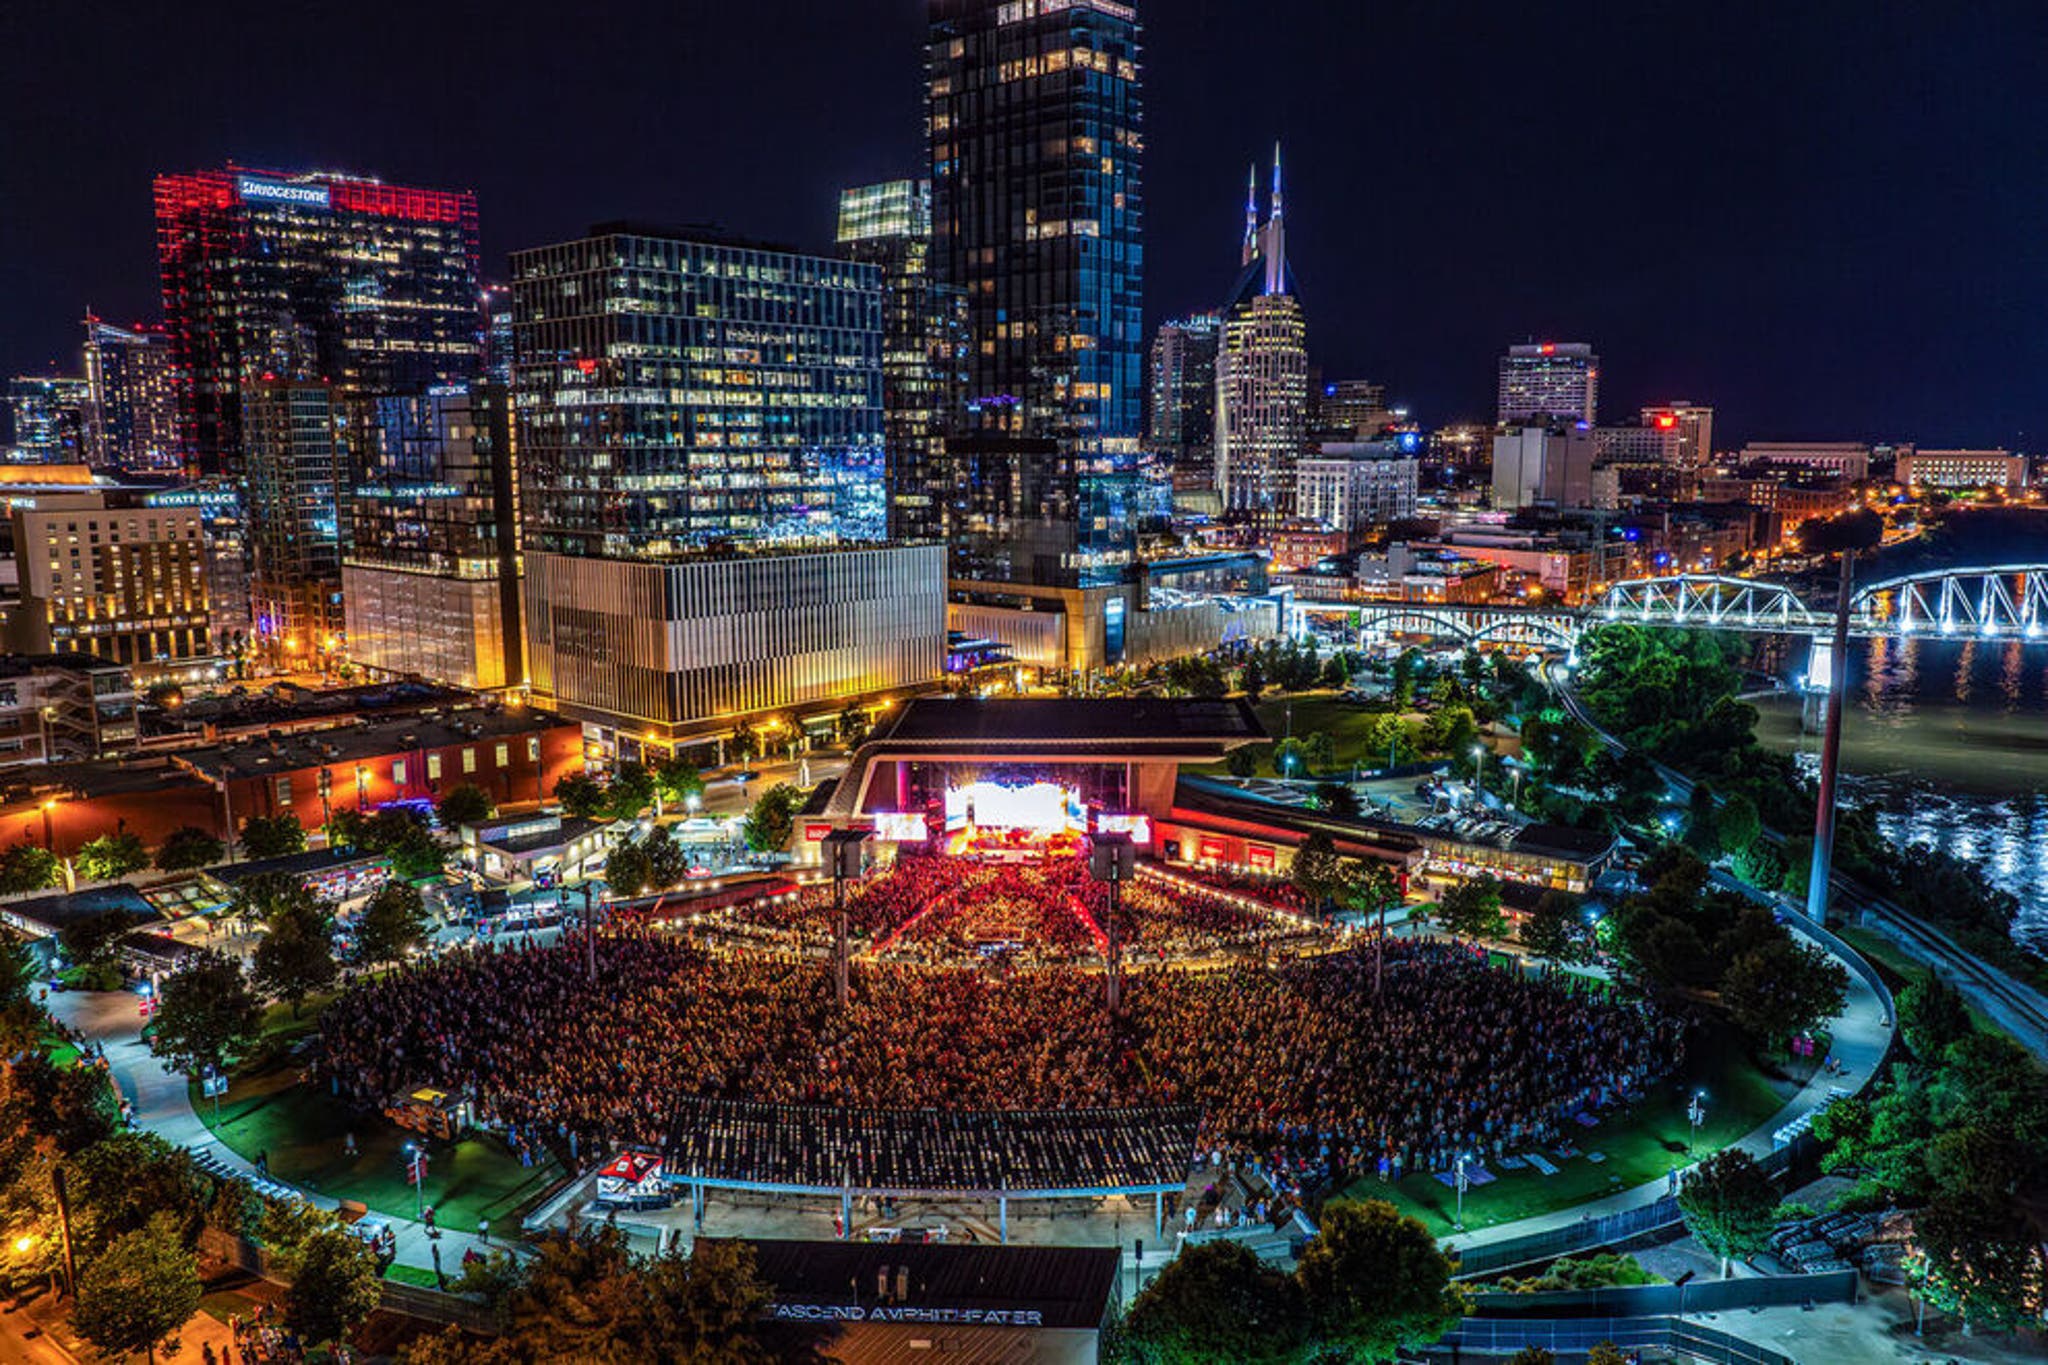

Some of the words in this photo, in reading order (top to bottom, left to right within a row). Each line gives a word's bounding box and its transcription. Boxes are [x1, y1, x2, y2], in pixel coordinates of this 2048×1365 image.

[243, 181, 328, 203] BRIDGESTONE
[159, 494, 196, 505] HYATT
[199, 493, 237, 505] PLACE
[777, 1304, 866, 1320] ASCEND
[870, 1306, 1043, 1326] AMPHITHEATER
